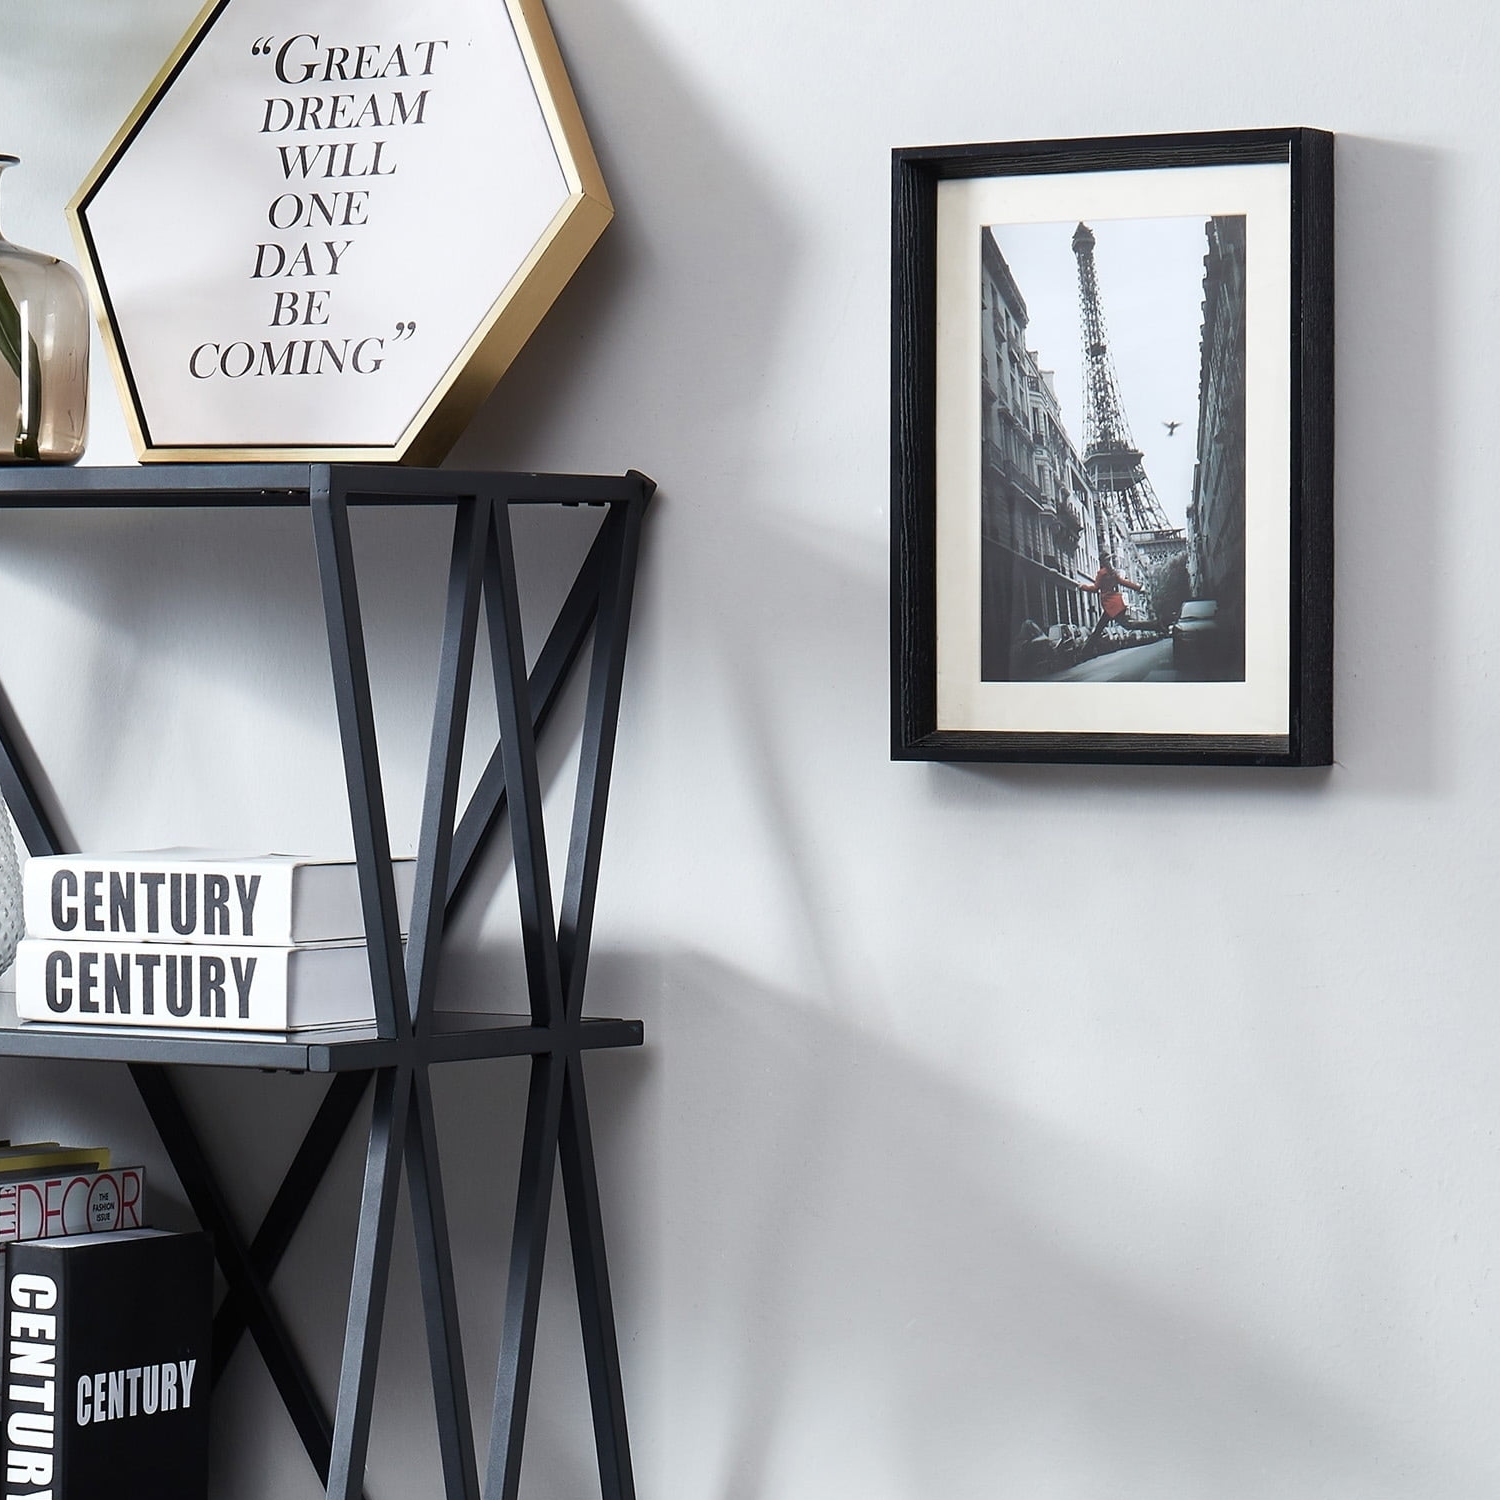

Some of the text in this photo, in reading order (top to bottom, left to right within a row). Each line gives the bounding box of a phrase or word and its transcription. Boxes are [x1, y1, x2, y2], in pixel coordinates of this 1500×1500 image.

[258, 90, 432, 134] DREAM
[275, 141, 398, 180] WILL
[267, 191, 371, 229] ONE
[249, 241, 353, 280] DAY
[268, 290, 333, 327] BE
[51, 869, 262, 937] CENTURY
[45, 950, 258, 1019] CENTURY
[0, 1184, 16, 1255] LLE
[92, 1203, 115, 1212] FASHION
[96, 1212, 110, 1222] ISSUE
[76, 1359, 197, 1427] CENTURY
